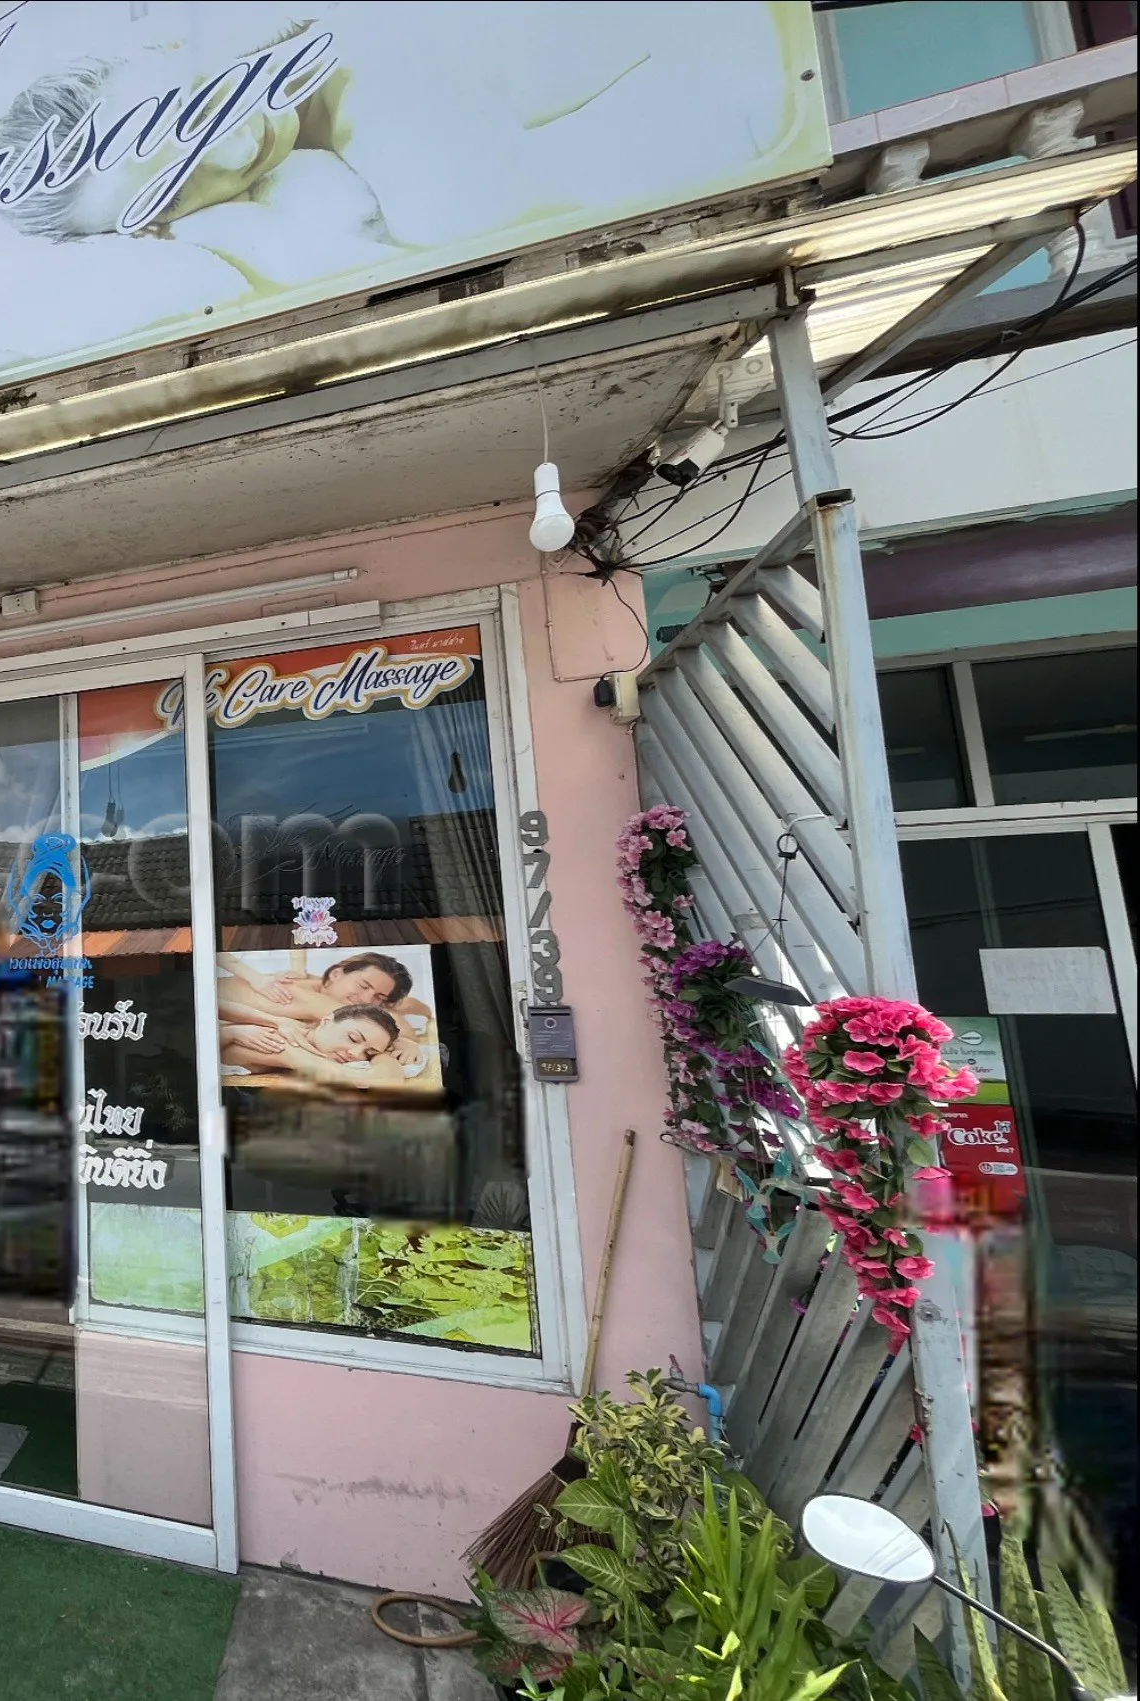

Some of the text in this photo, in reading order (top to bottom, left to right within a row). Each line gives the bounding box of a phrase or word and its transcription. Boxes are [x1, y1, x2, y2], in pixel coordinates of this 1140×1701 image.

[223, 669, 309, 719] Care
[313, 650, 461, 711] Massage
[949, 1127, 1006, 1146] Coke
